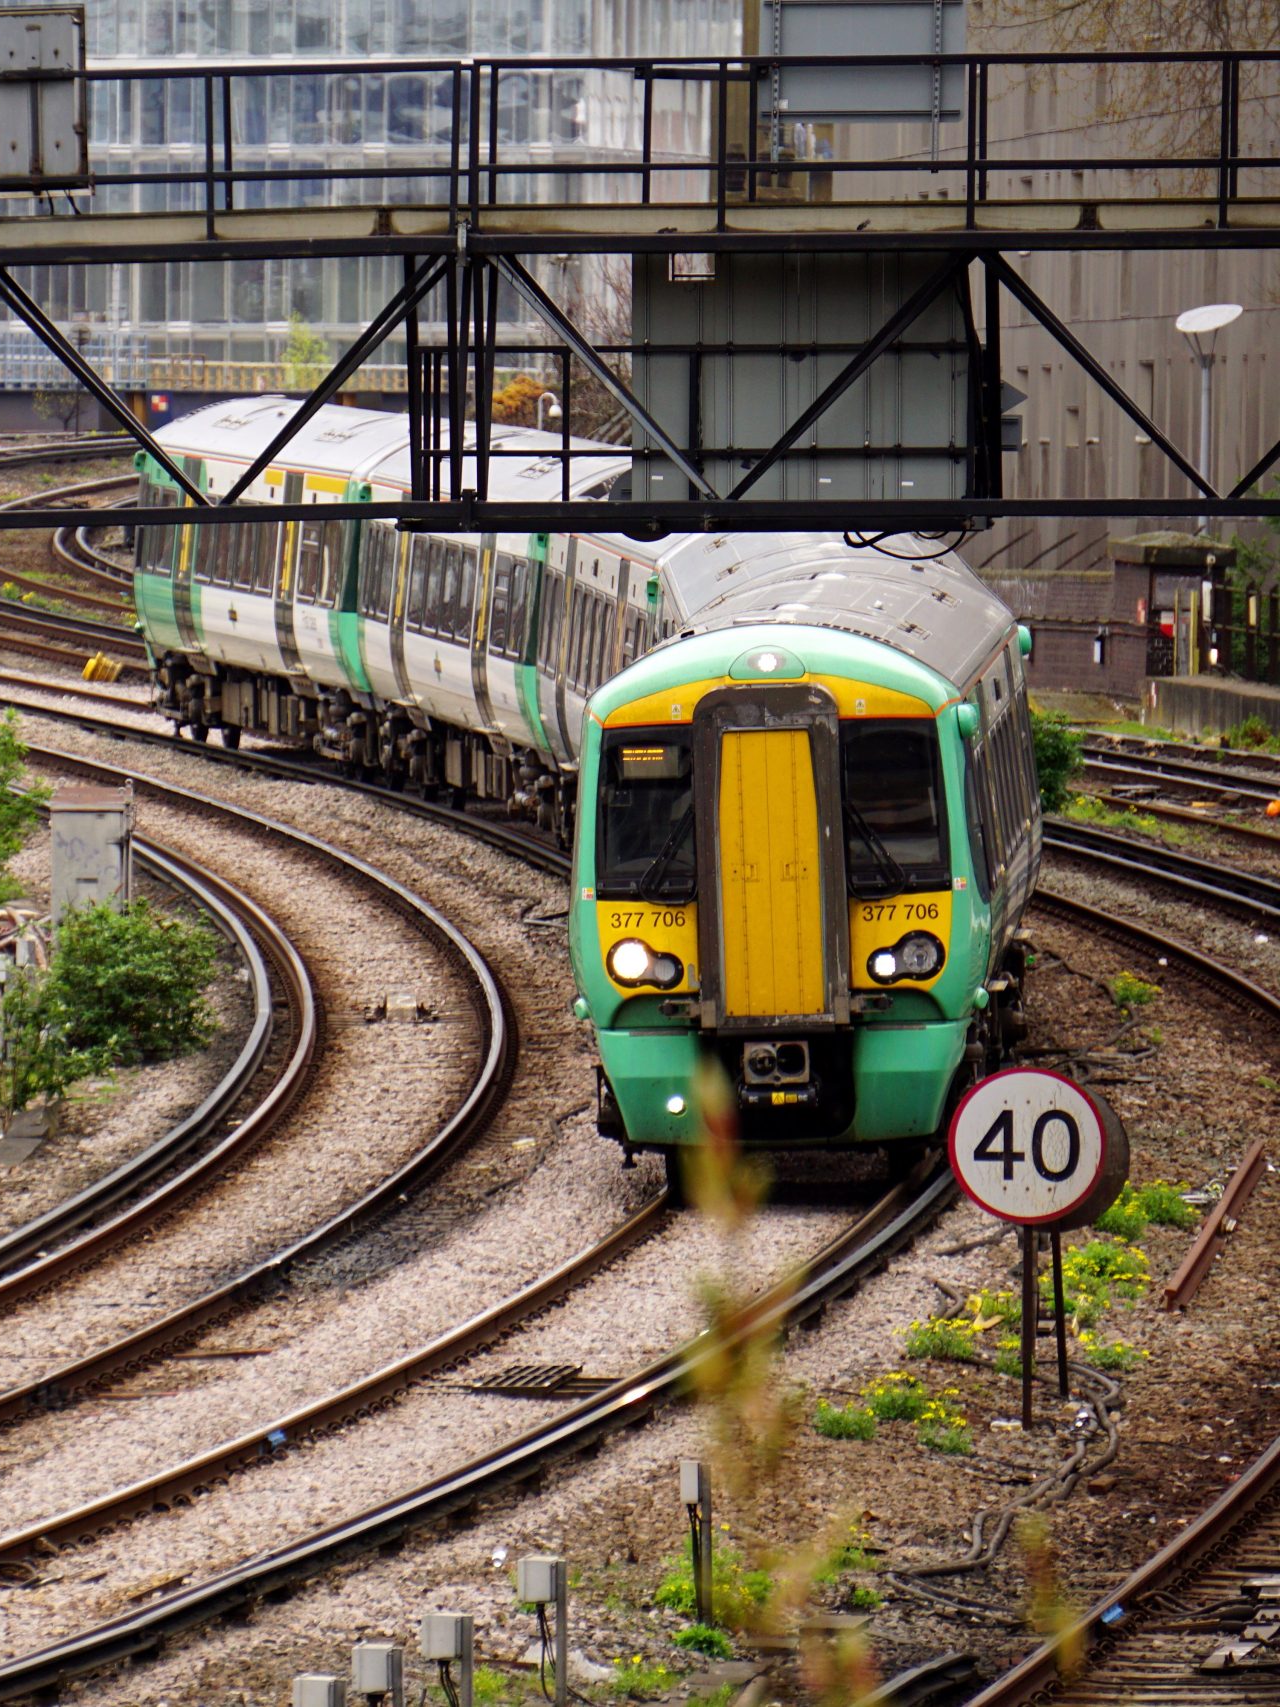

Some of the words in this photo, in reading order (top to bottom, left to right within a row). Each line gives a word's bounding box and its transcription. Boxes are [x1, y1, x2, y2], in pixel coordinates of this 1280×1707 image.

[611, 912, 644, 928] 377
[651, 911, 686, 927] 706
[863, 905, 897, 922] 377
[904, 903, 939, 920] 706
[973, 1109, 1081, 1182] 40
